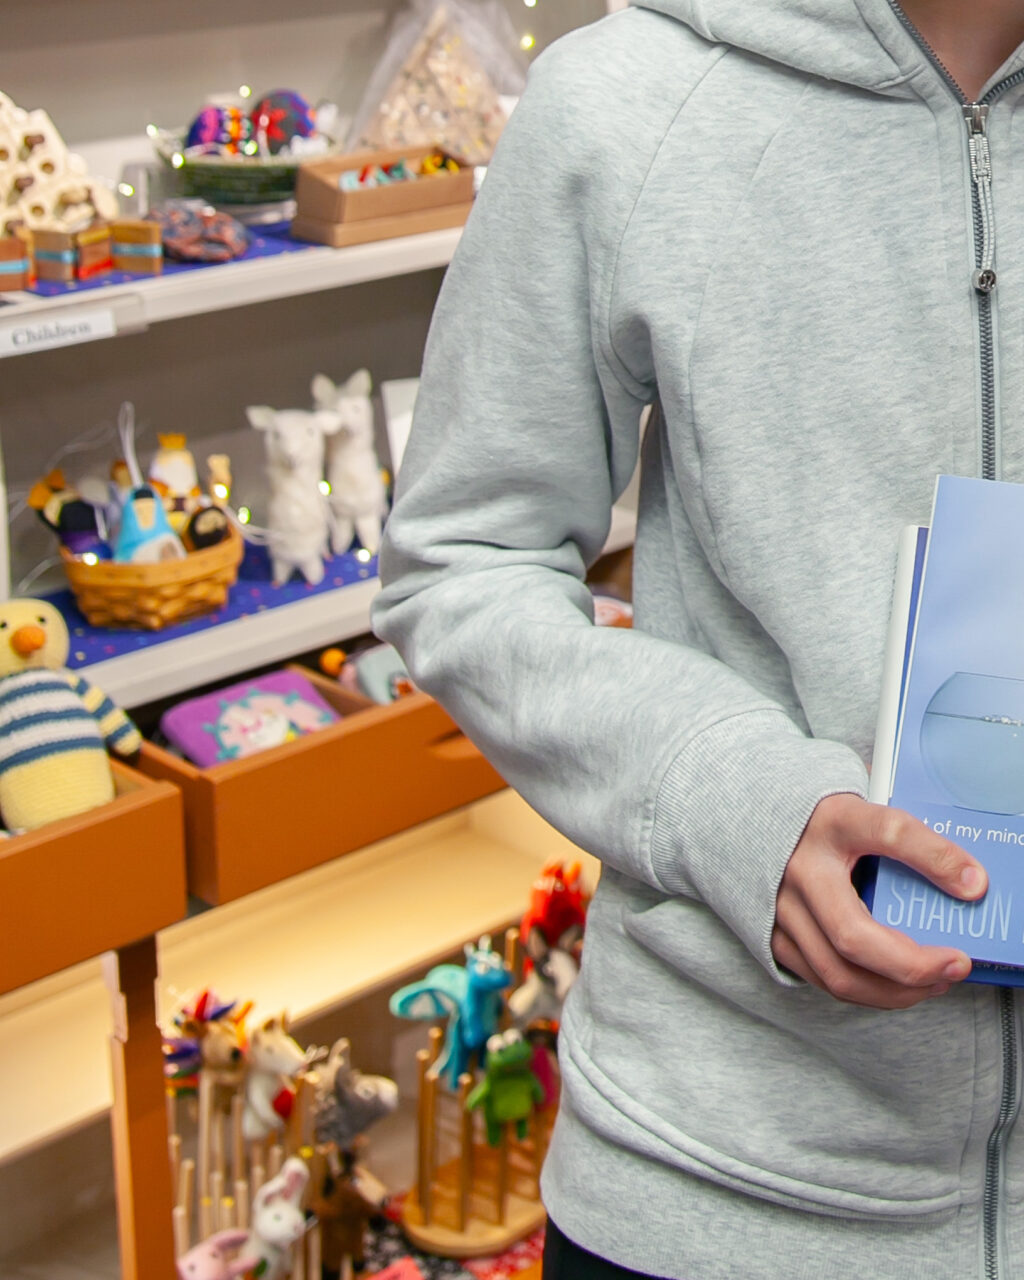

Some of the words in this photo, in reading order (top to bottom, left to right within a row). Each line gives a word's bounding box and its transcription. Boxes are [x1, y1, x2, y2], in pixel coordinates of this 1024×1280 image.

[933, 820, 952, 835] of
[955, 825, 982, 842] my
[886, 875, 1013, 943] SHARON
